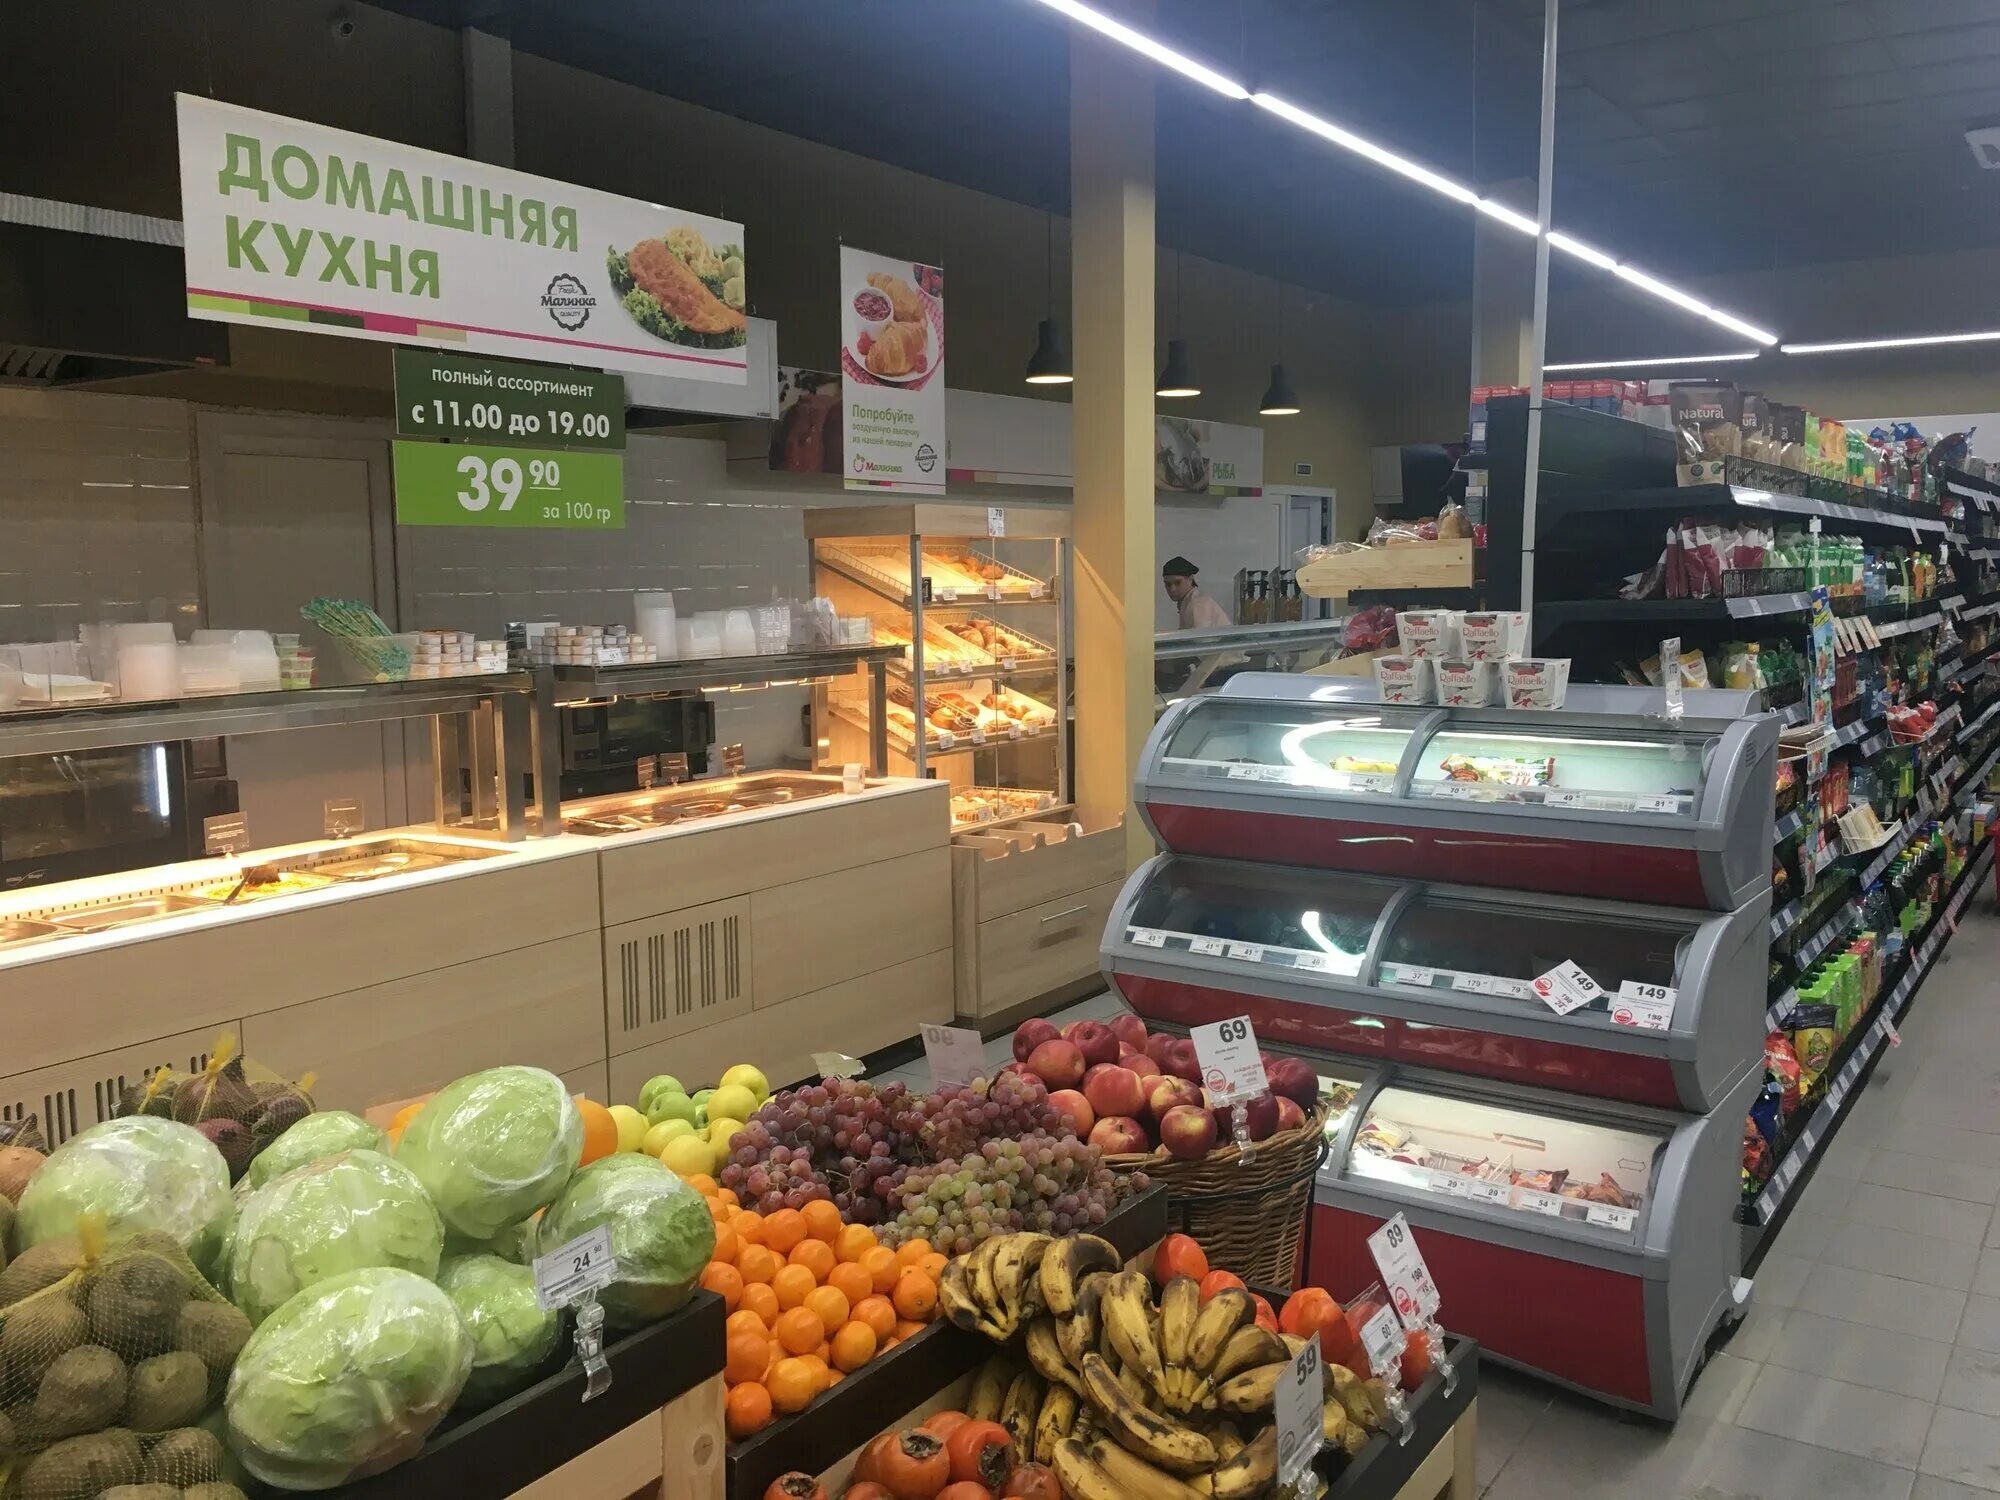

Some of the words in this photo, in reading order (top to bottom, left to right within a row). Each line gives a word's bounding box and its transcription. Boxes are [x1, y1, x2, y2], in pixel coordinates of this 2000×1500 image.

[218, 132, 579, 253] ДОМАШНЯЯ
[225, 215, 440, 299] КУХНЯ
[540, 295, 597, 307] Малинка
[432, 368, 493, 388] полный
[497, 374, 594, 398] ассортимент
[411, 404, 425, 424] с
[433, 399, 502, 430] 11.00
[508, 413, 540, 436] до
[548, 410, 610, 439] 19.00
[852, 404, 914, 424] Попробуйте
[1680, 408, 1724, 420] Natural
[456, 455, 523, 512] 39
[529, 460, 560, 486] 90
[543, 505, 560, 519] за
[566, 502, 593, 520] 100
[597, 508, 611, 524] гр
[1403, 626, 1440, 636] Raffaello
[1462, 627, 1499, 638] Raffaello
[1380, 670, 1416, 681] Raffaello
[1440, 674, 1477, 683] Raffaello
[1507, 674, 1547, 686] Raffaello
[1467, 979, 1481, 987] 179
[1570, 970, 1595, 991] 149
[1636, 985, 1667, 1000] 149
[1219, 1019, 1247, 1043] 69
[1488, 1188, 1498, 1197] 29
[1538, 1200, 1548, 1208] 54
[1608, 1214, 1619, 1222] 54
[1387, 1223, 1404, 1249] 89
[573, 1251, 590, 1273] 24
[1296, 1344, 1317, 1386] 59
